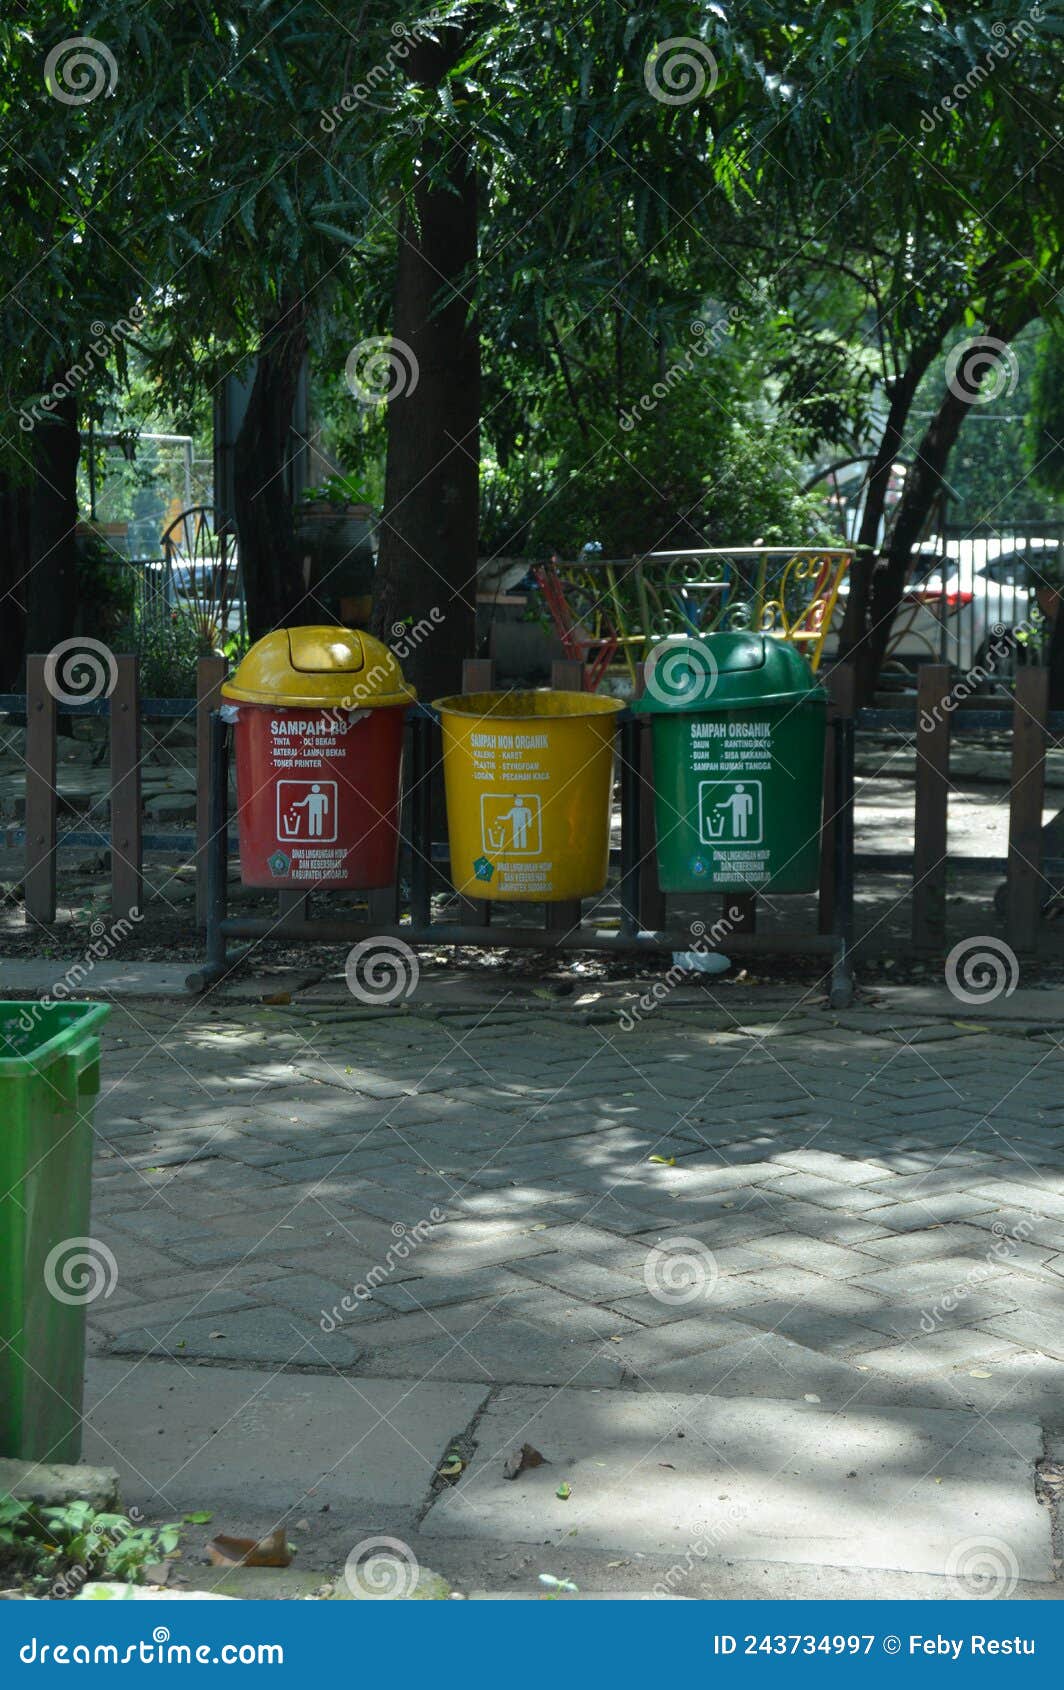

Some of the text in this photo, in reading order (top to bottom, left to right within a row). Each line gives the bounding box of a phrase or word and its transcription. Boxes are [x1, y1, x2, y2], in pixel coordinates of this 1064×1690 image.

[271, 720, 326, 735] SAMPAH
[691, 723, 771, 738] SAMPAH ORGANIK
